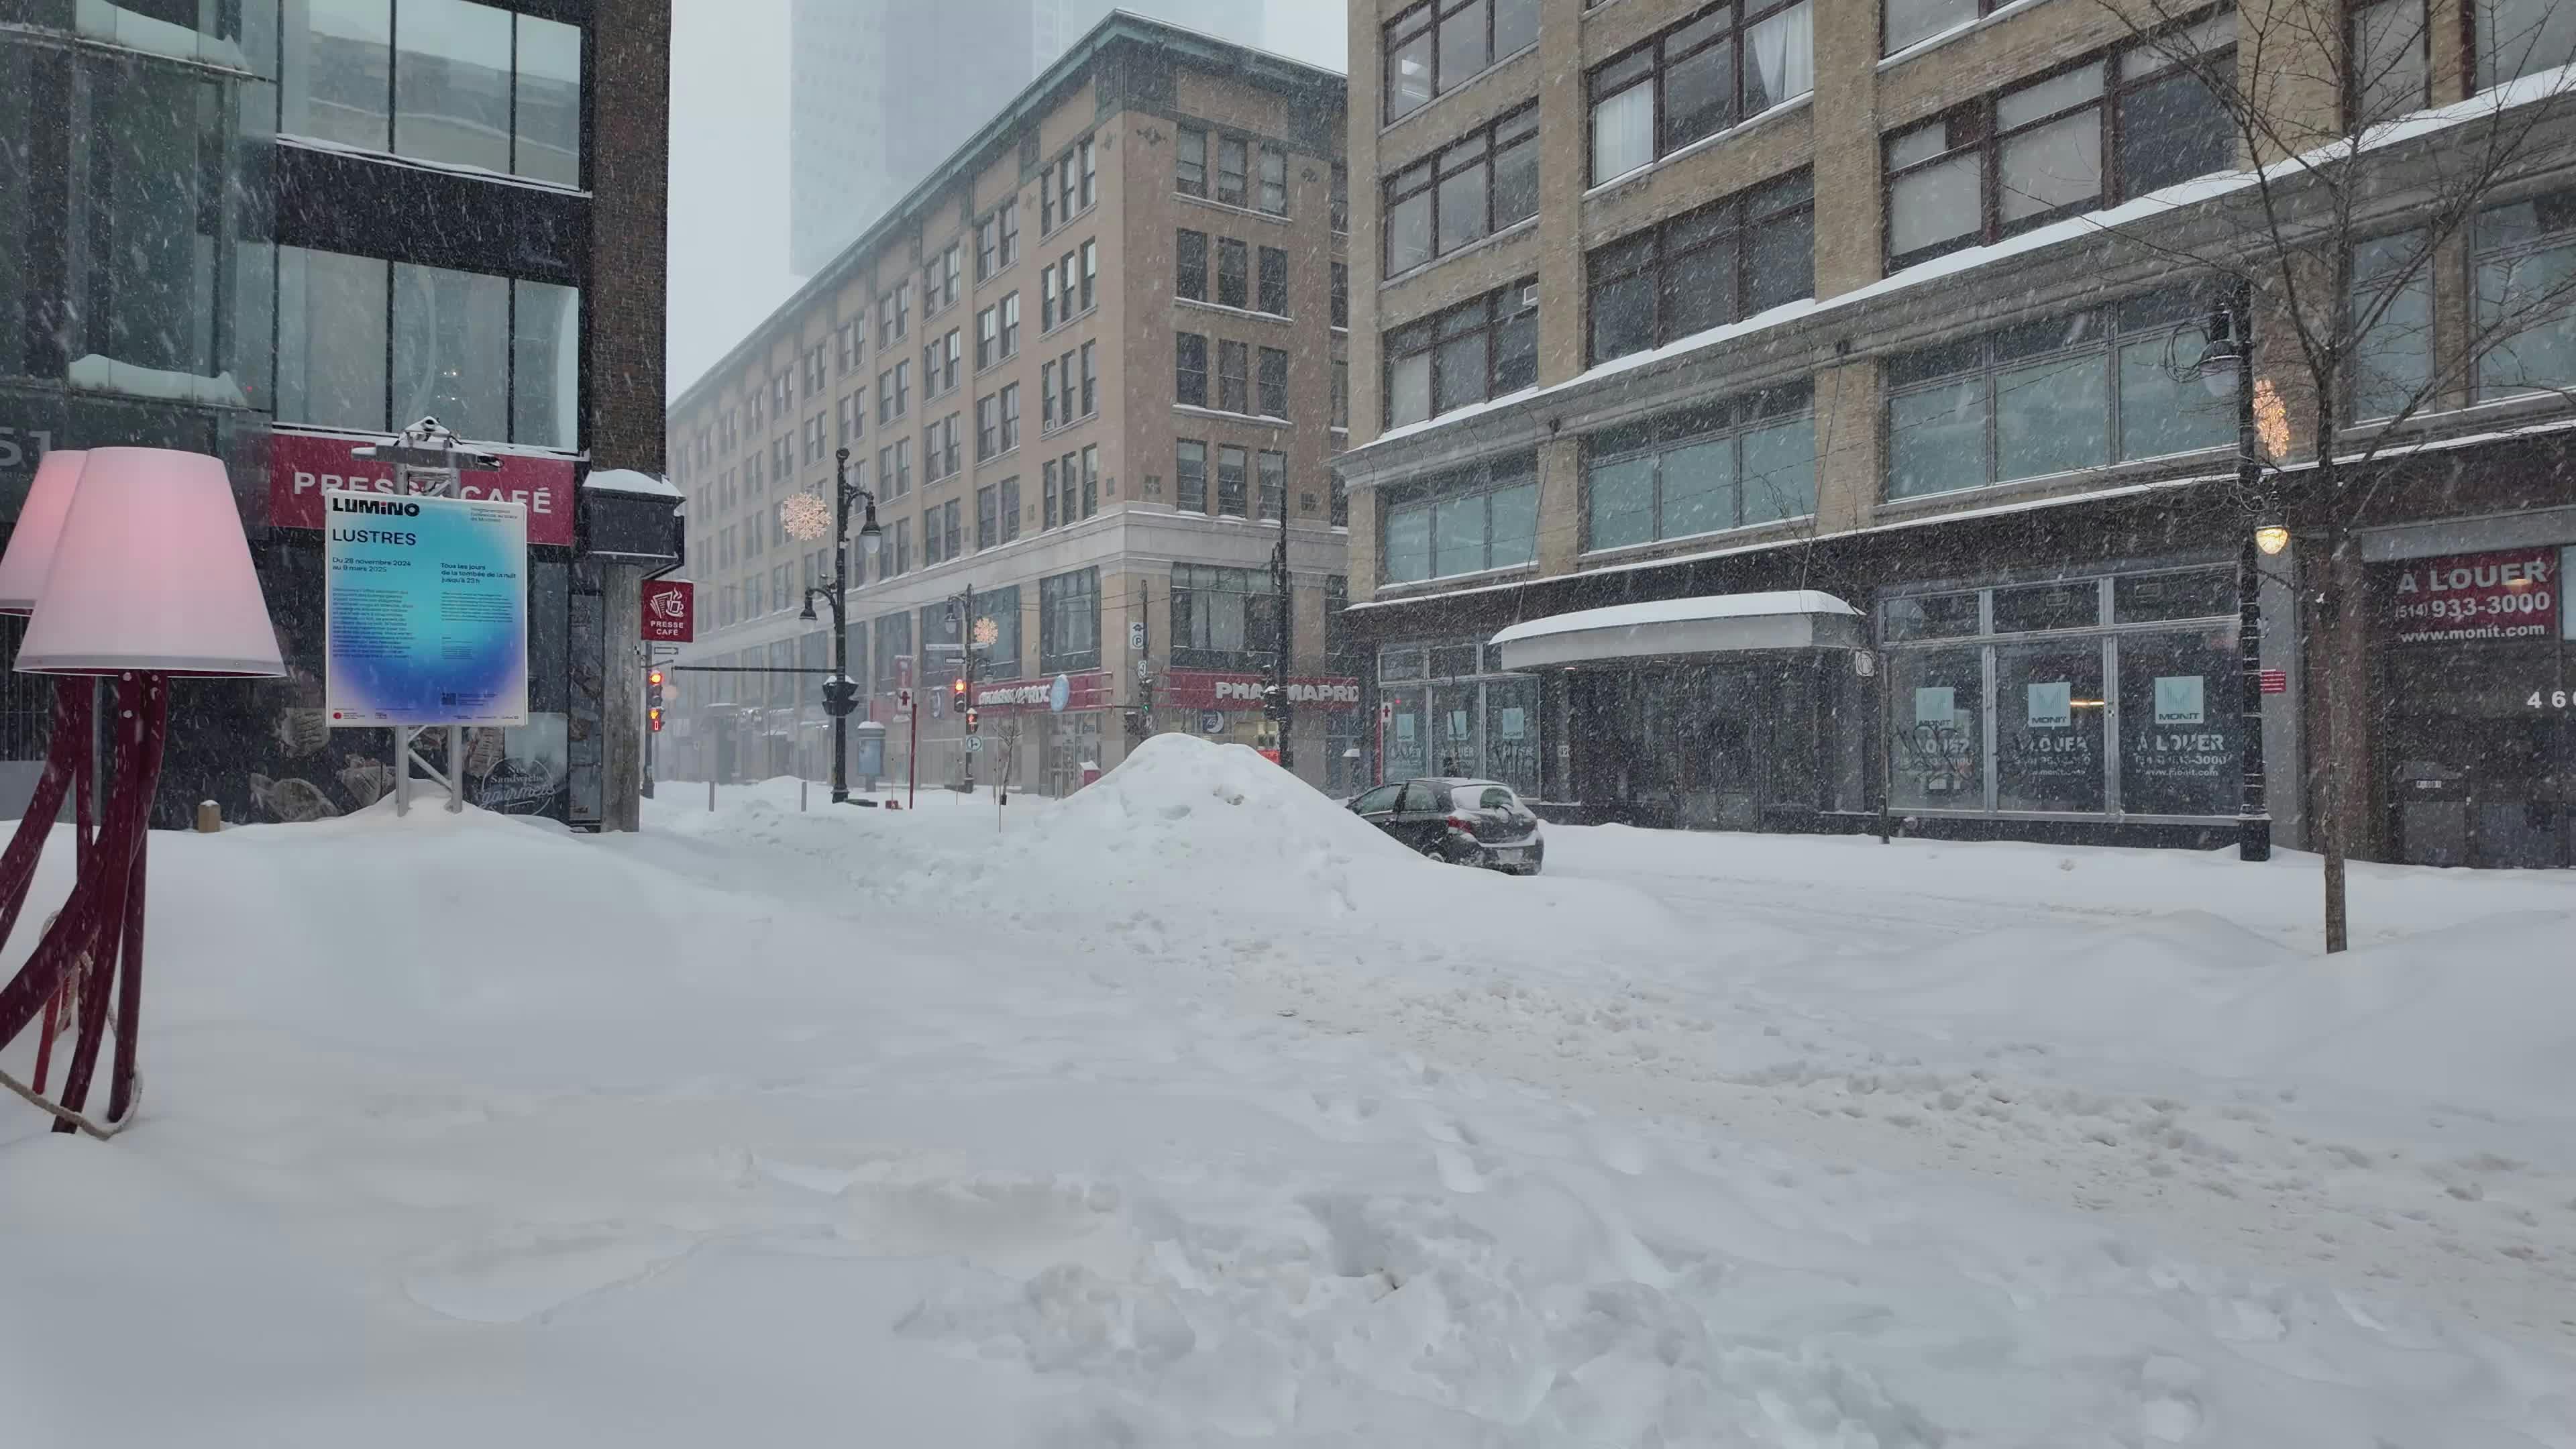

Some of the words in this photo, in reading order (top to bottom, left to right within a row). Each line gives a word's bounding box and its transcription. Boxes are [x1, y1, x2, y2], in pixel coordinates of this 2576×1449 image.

[333, 529, 417, 545] LUSTRES
[2429, 561, 2548, 591] LOUER
[2395, 603, 2428, 619] (514)
[2431, 591, 2551, 618] 933-3000
[650, 621, 684, 629] PRESSE
[2401, 624, 2545, 643] www.monit.com
